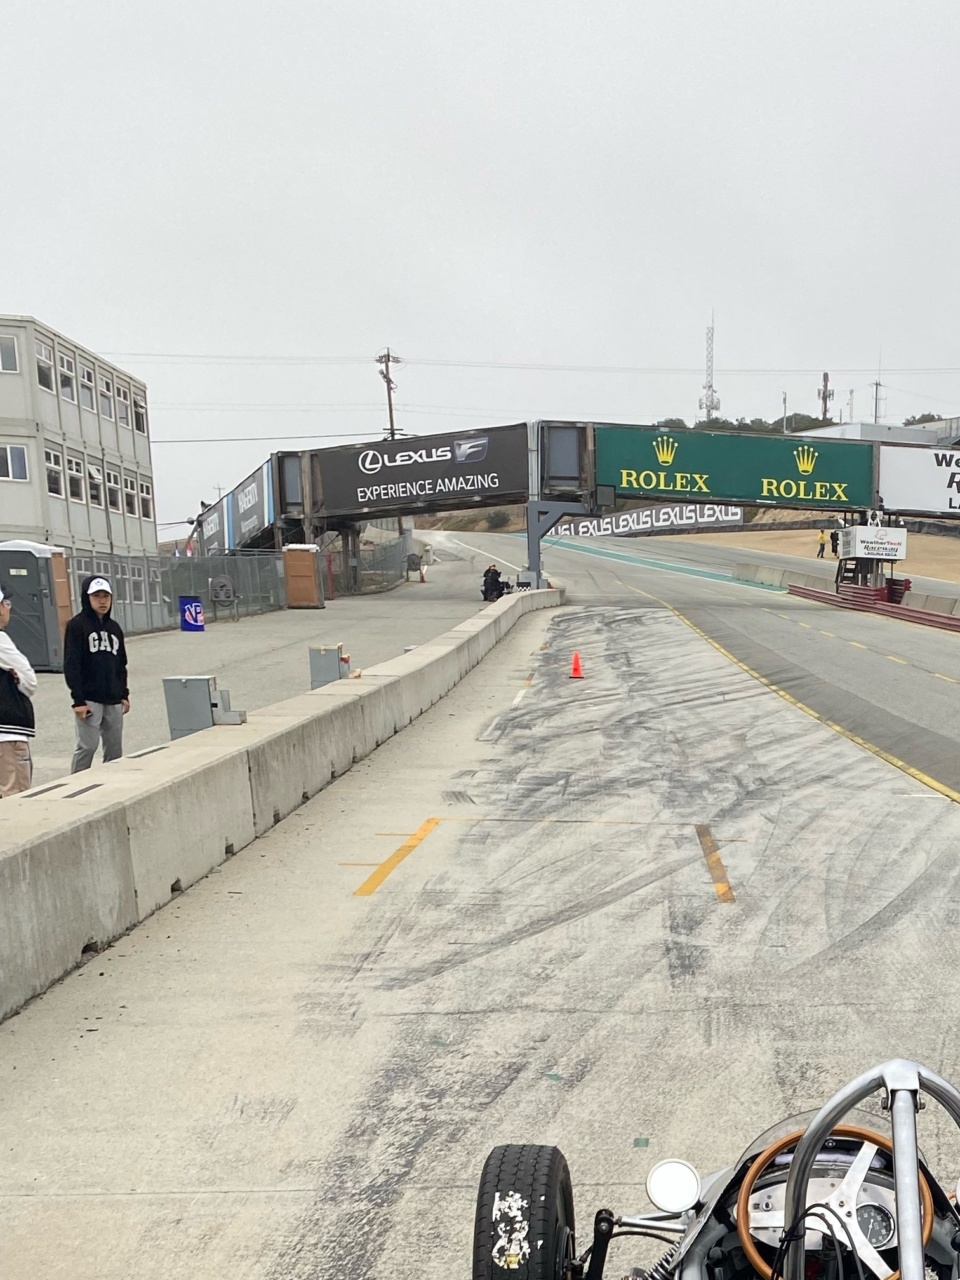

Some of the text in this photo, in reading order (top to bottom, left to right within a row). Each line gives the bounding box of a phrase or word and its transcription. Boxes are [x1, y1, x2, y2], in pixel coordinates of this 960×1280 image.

[383, 447, 452, 467] LEXUS
[357, 473, 499, 502] EXPERIENCE AMAZING
[619, 469, 711, 493] ROLEX
[760, 478, 849, 501] ROLEX
[571, 517, 612, 536] LEXUS
[612, 510, 651, 533] LEXUS
[652, 505, 696, 527] LEXUS
[696, 503, 742, 523] LEXUS
[185, 603, 203, 625] VP
[88, 631, 120, 656] GAP
